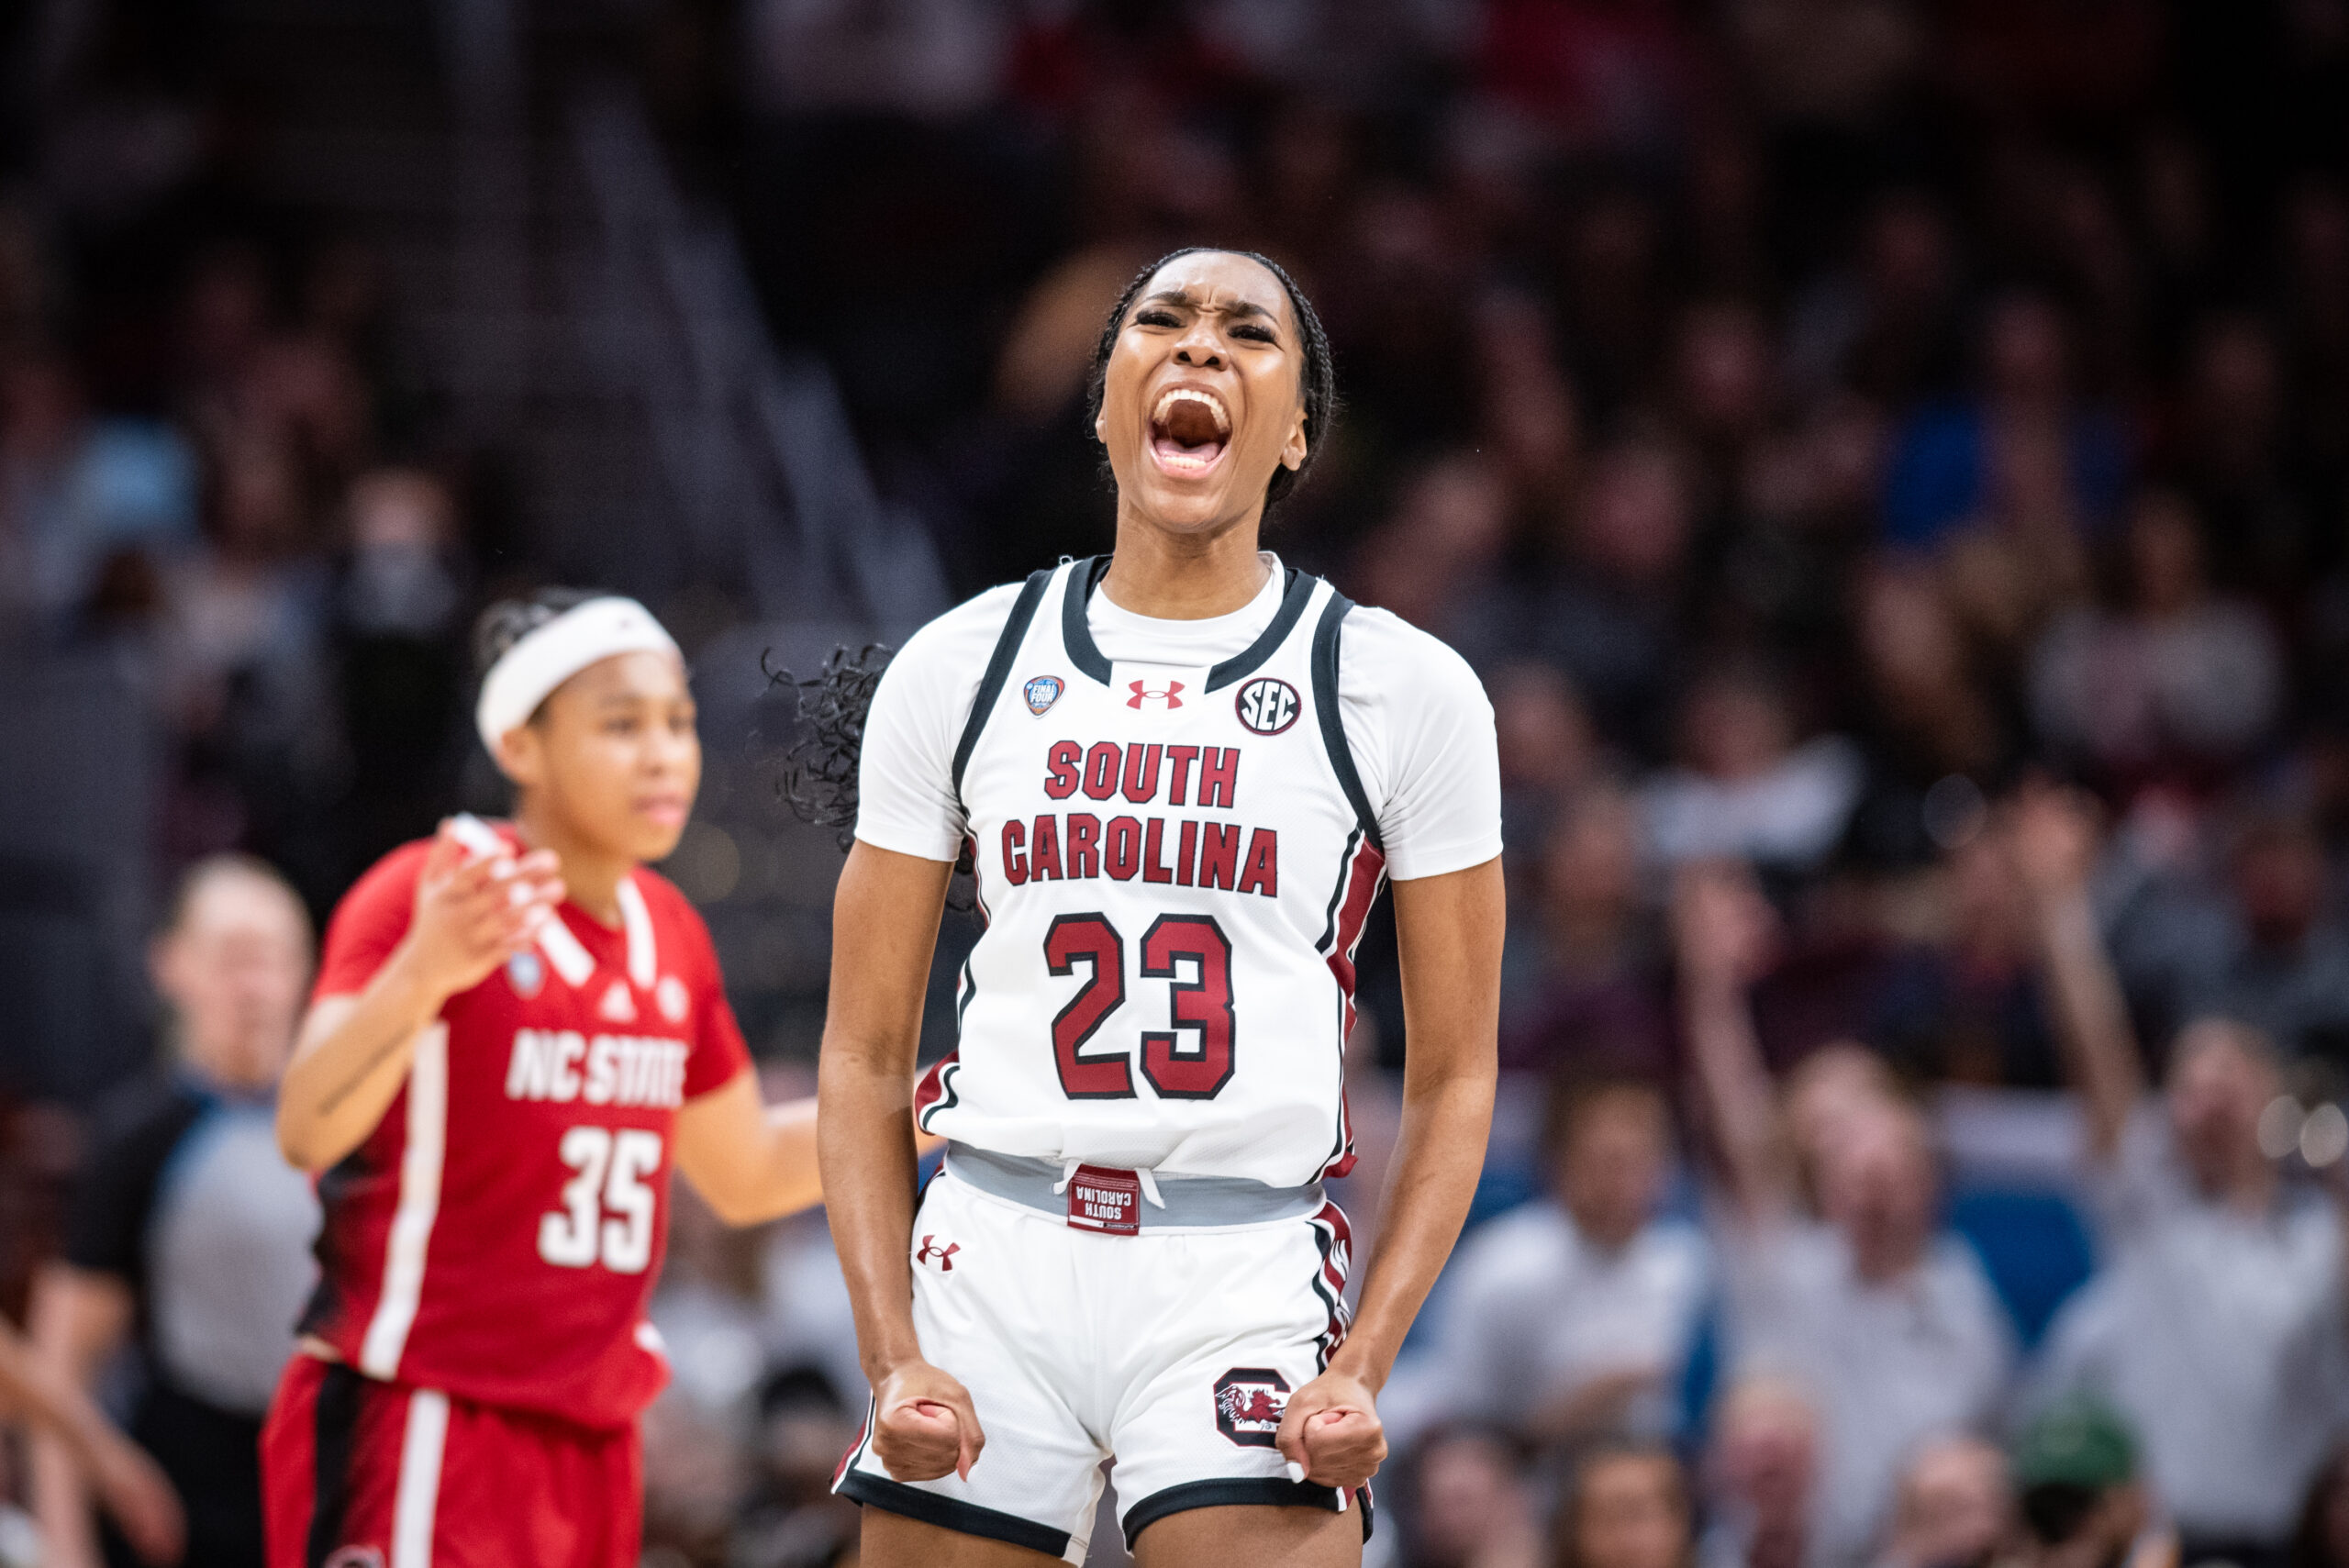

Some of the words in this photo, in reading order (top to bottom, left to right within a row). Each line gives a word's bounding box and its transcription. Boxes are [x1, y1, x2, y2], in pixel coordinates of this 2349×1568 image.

[1030, 693, 1052, 703] FOUR
[1032, 684, 1054, 694] FINAL
[1241, 681, 1296, 730] SEC
[1044, 740, 1241, 808] SOUTH
[1001, 813, 1278, 897] CAROLINA
[1043, 912, 1236, 1101] 23
[506, 1028, 586, 1102] NC
[585, 1033, 689, 1107] STATE
[538, 1125, 662, 1273] 35
[1075, 1185, 1131, 1207] CAROLINA
[1085, 1203, 1122, 1220] SOUTH
